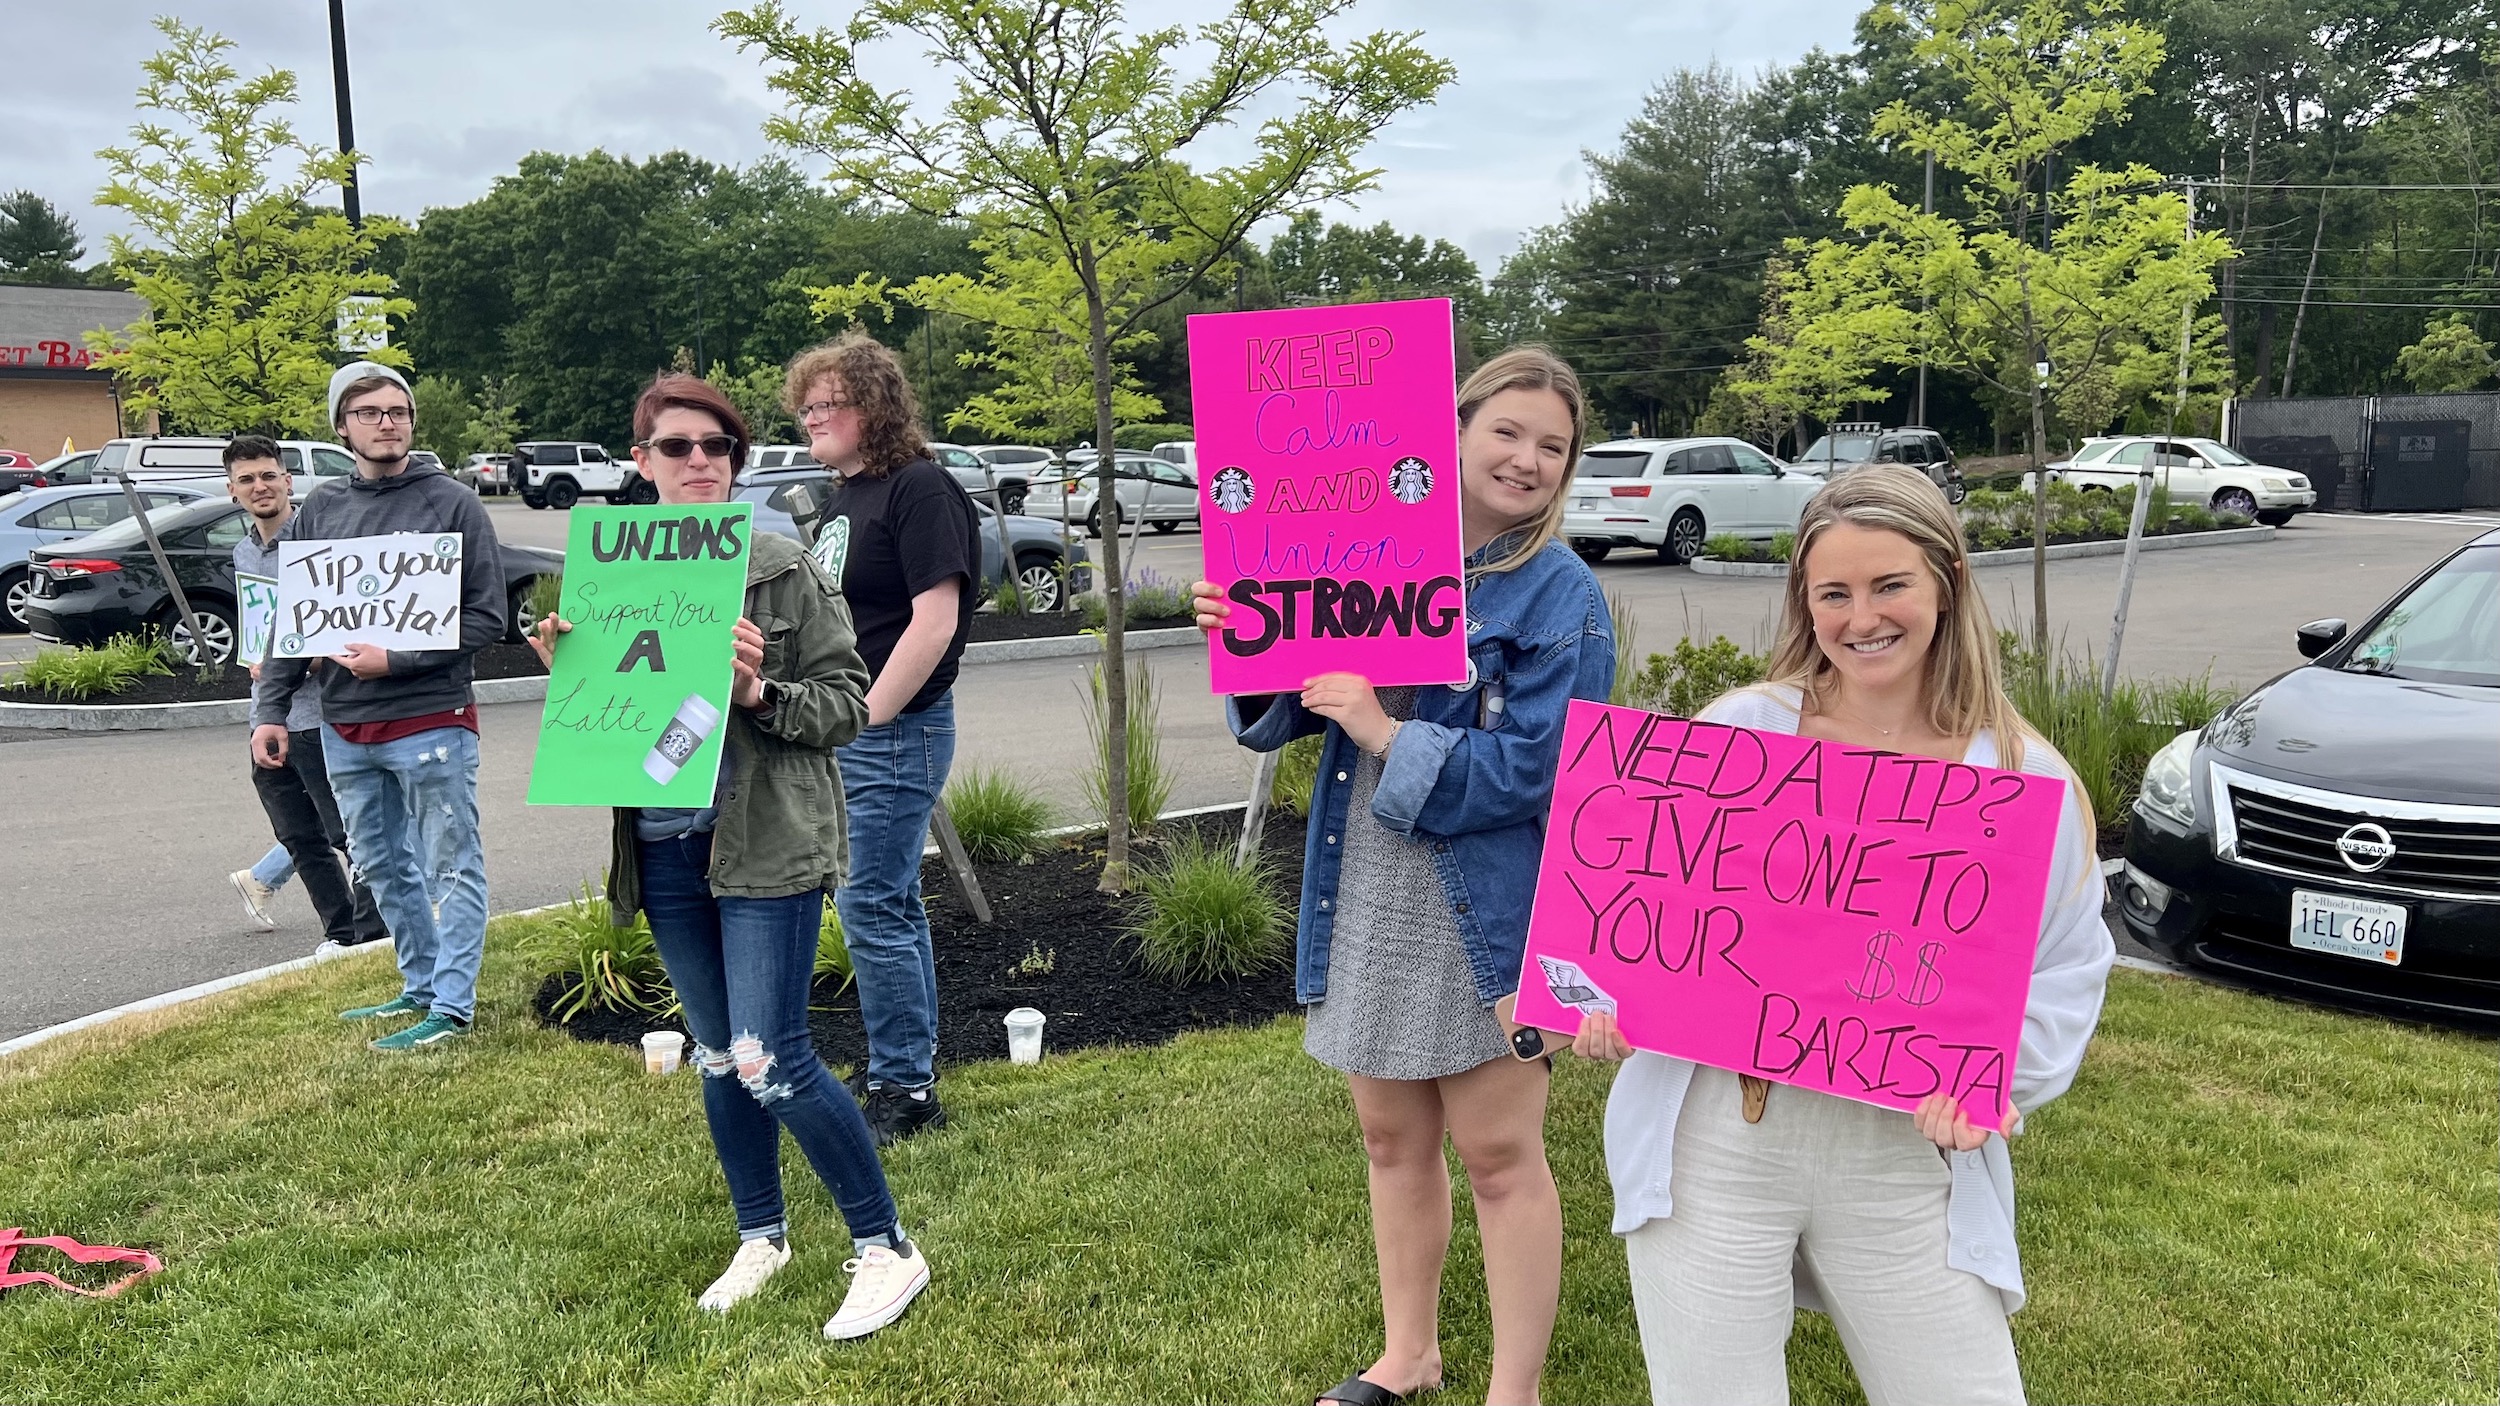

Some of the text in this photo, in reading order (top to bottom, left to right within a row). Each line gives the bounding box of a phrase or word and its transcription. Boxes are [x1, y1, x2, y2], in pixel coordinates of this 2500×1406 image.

[1247, 327, 1394, 393] KEEP
[1256, 390, 1399, 456] Calm
[1266, 467, 1380, 514] AND
[592, 514, 747, 563] UNIONS
[1220, 523, 1424, 578] Union
[286, 546, 364, 596] Tip
[293, 592, 458, 639] Barista!
[566, 581, 721, 634] Support You
[1222, 575, 1462, 657] STRONG
[615, 629, 667, 673] A
[545, 677, 653, 733] Latte
[1567, 711, 2026, 838] NEED A TIP?
[1570, 785, 1991, 934] GIVE ONE TO
[2341, 841, 2387, 854] NISSAN
[1564, 870, 1760, 988] YOUR
[2302, 907, 2396, 947] 1EL 660
[2319, 897, 2381, 915] Rhode Island
[2319, 940, 2348, 952] Ocean
[2351, 945, 2375, 957] State
[1753, 993, 2006, 1117] BARISTA
